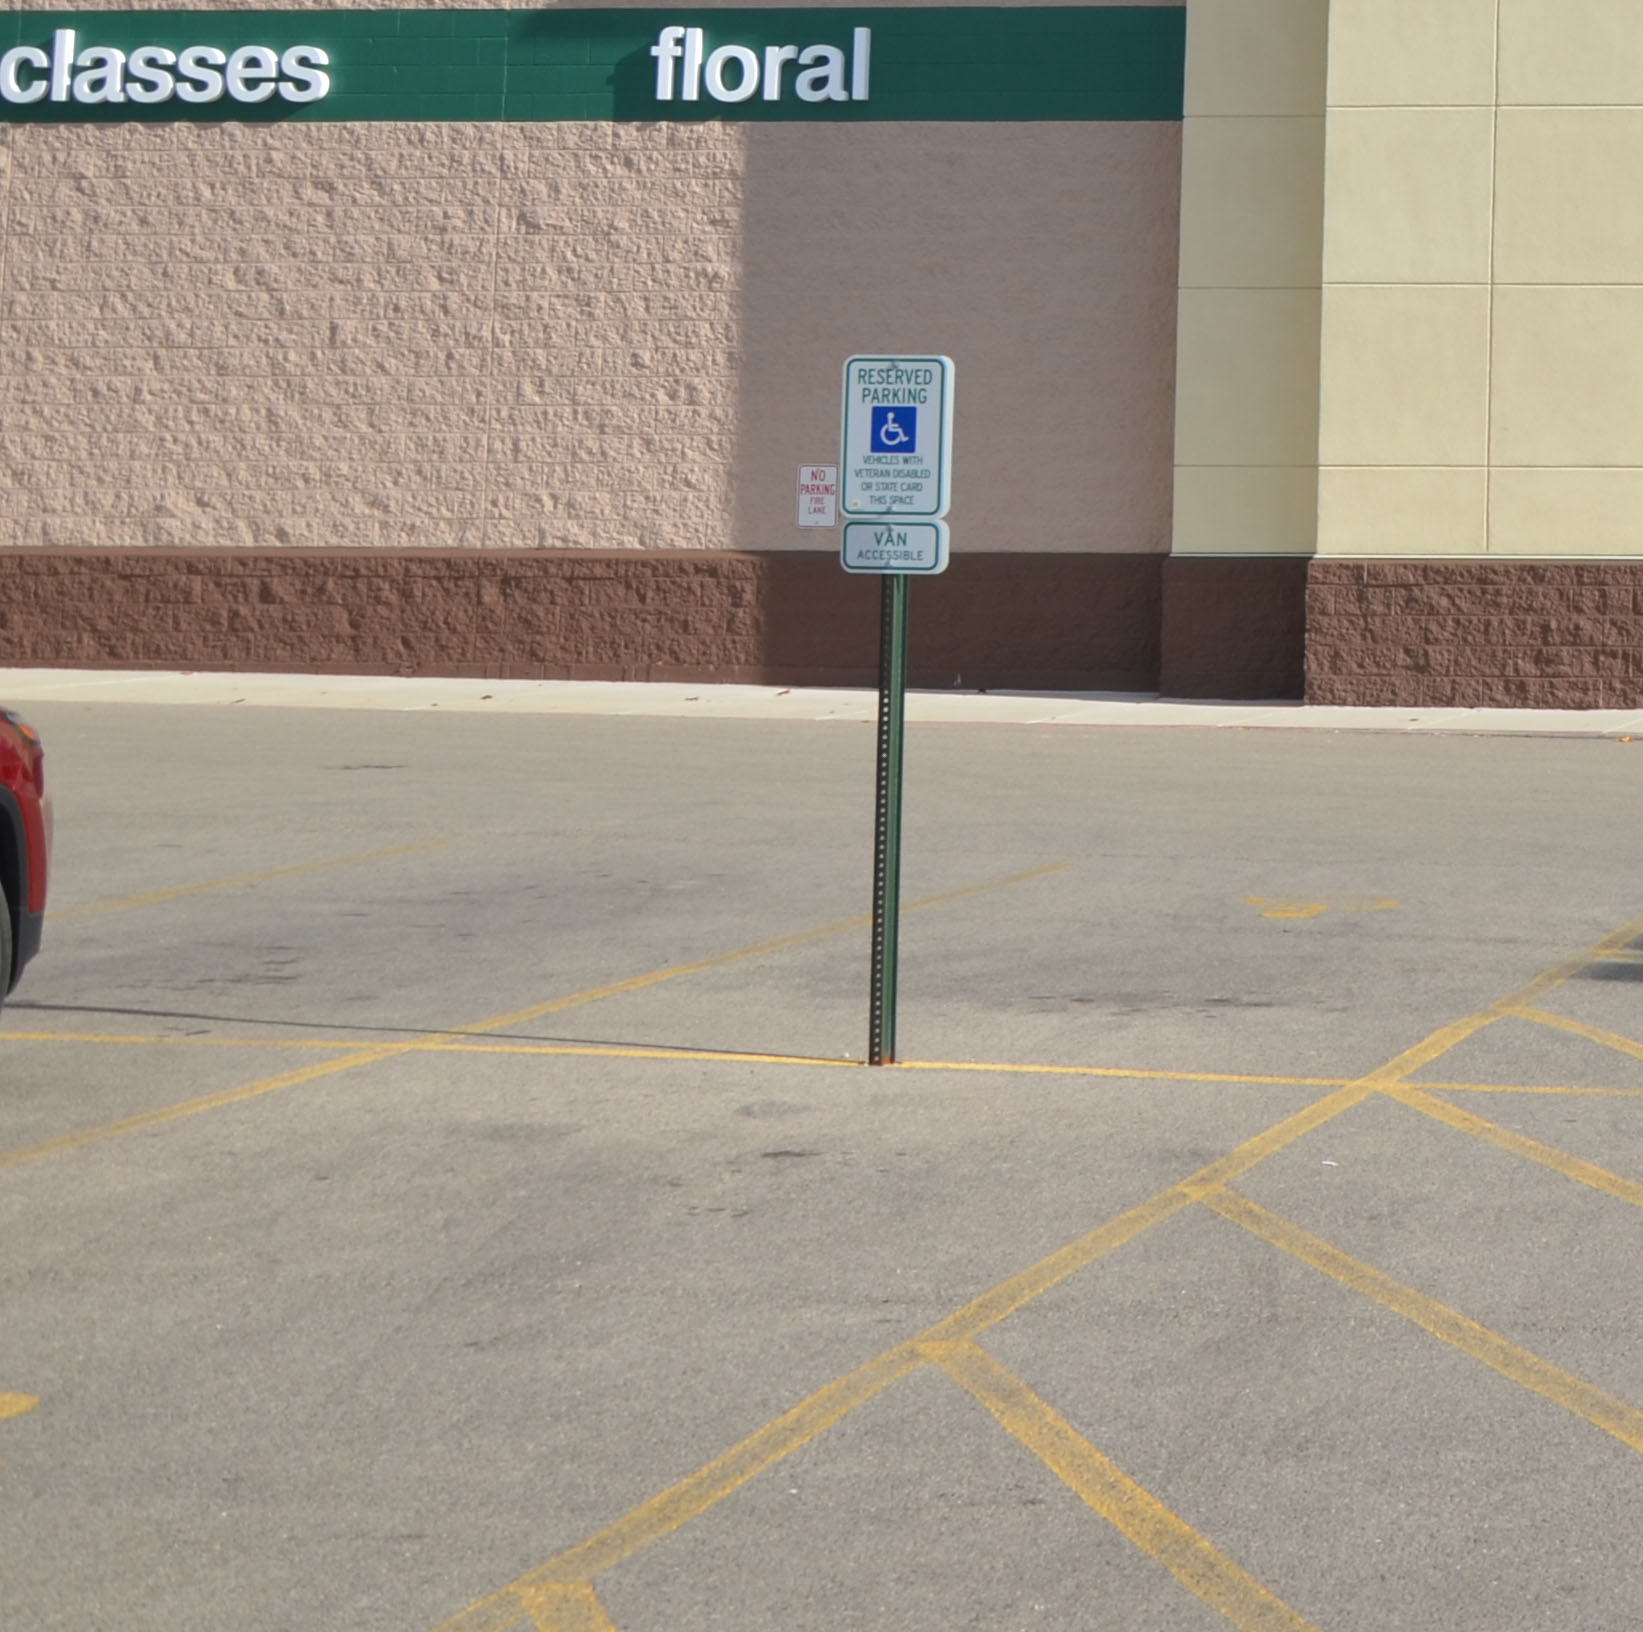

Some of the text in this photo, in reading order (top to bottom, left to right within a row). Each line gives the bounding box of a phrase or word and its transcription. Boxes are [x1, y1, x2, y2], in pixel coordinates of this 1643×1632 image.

[0, 29, 330, 103] classes
[651, 26, 871, 101] floral
[858, 368, 933, 385] RESERVED
[862, 388, 928, 404] PARKING
[863, 456, 924, 465] VEHICLES WITH
[810, 469, 826, 482] NO
[855, 469, 931, 479] VETERAN DISABLED
[800, 484, 836, 495] PARKING
[861, 482, 923, 492] OR STATE CARD
[870, 495, 915, 505] THIS SPACE
[808, 506, 826, 515] LANE
[874, 532, 907, 546] VAN
[857, 550, 924, 560] ACCESSIBLE
